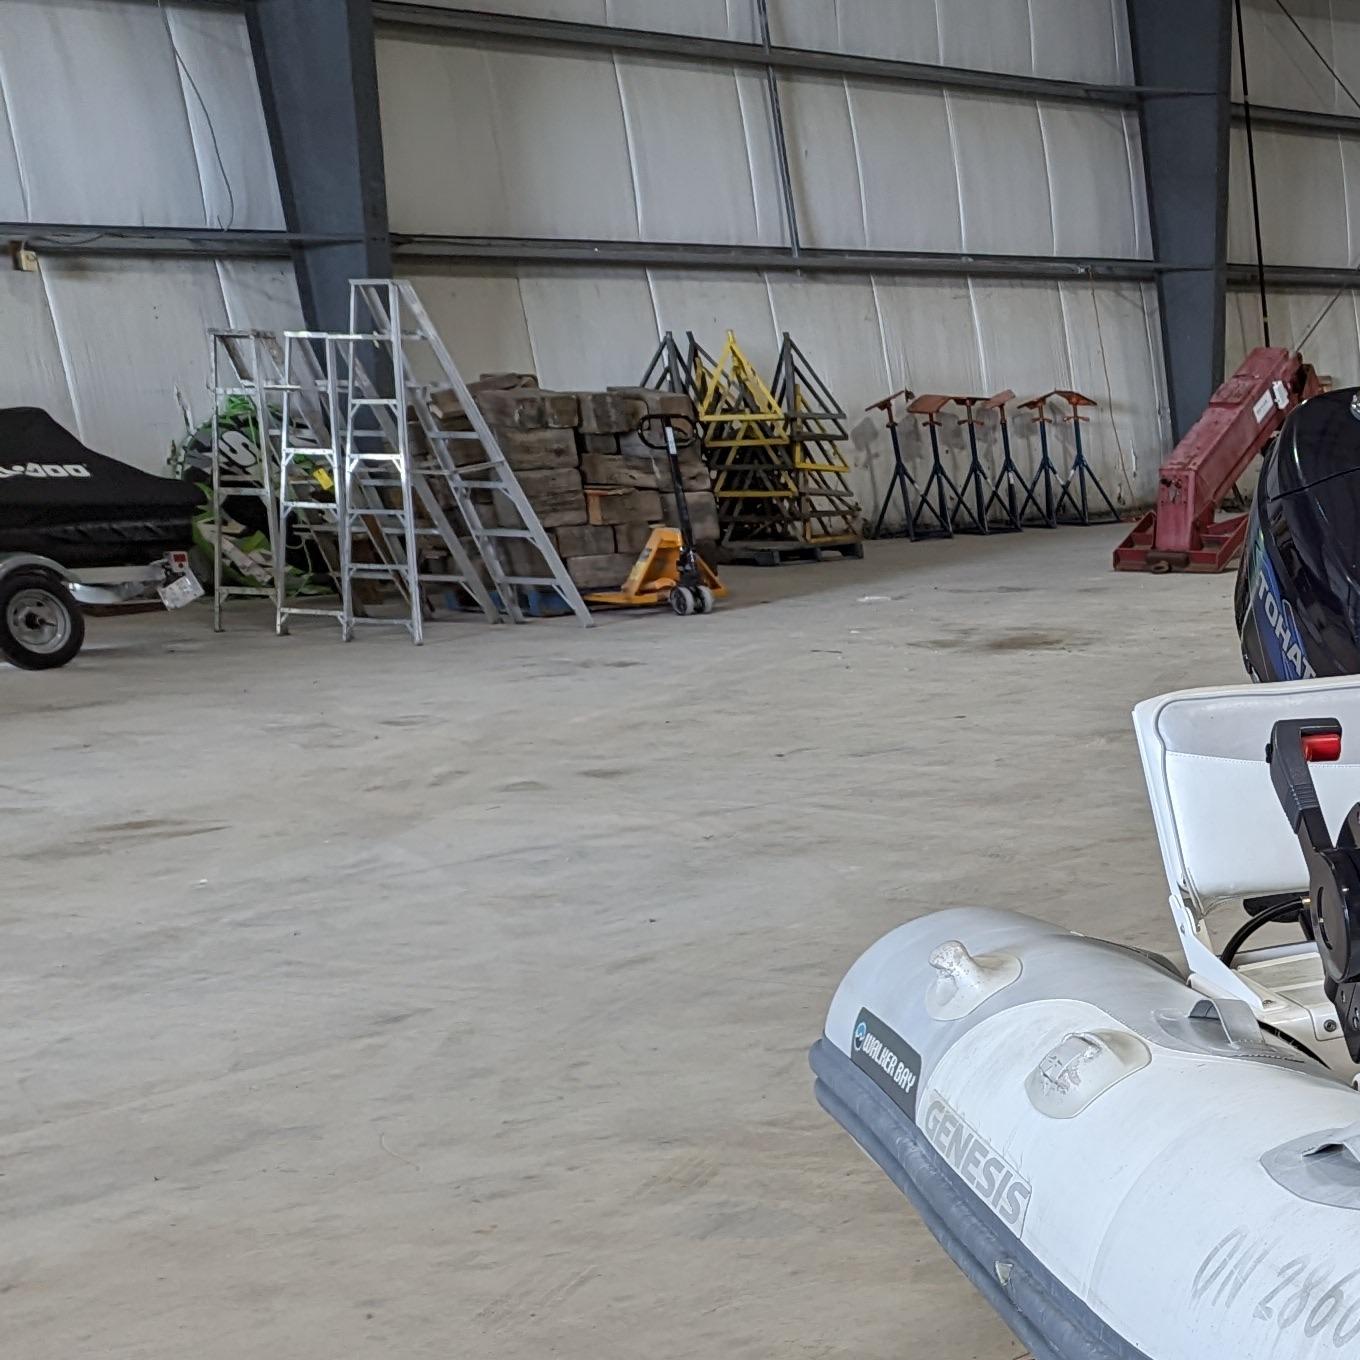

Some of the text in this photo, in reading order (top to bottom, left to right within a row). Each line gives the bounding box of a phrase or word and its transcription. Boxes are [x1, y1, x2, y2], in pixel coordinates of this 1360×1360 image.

[862, 1032, 917, 1094] WALKER BAY
[924, 1100, 1033, 1225] GENESIS
